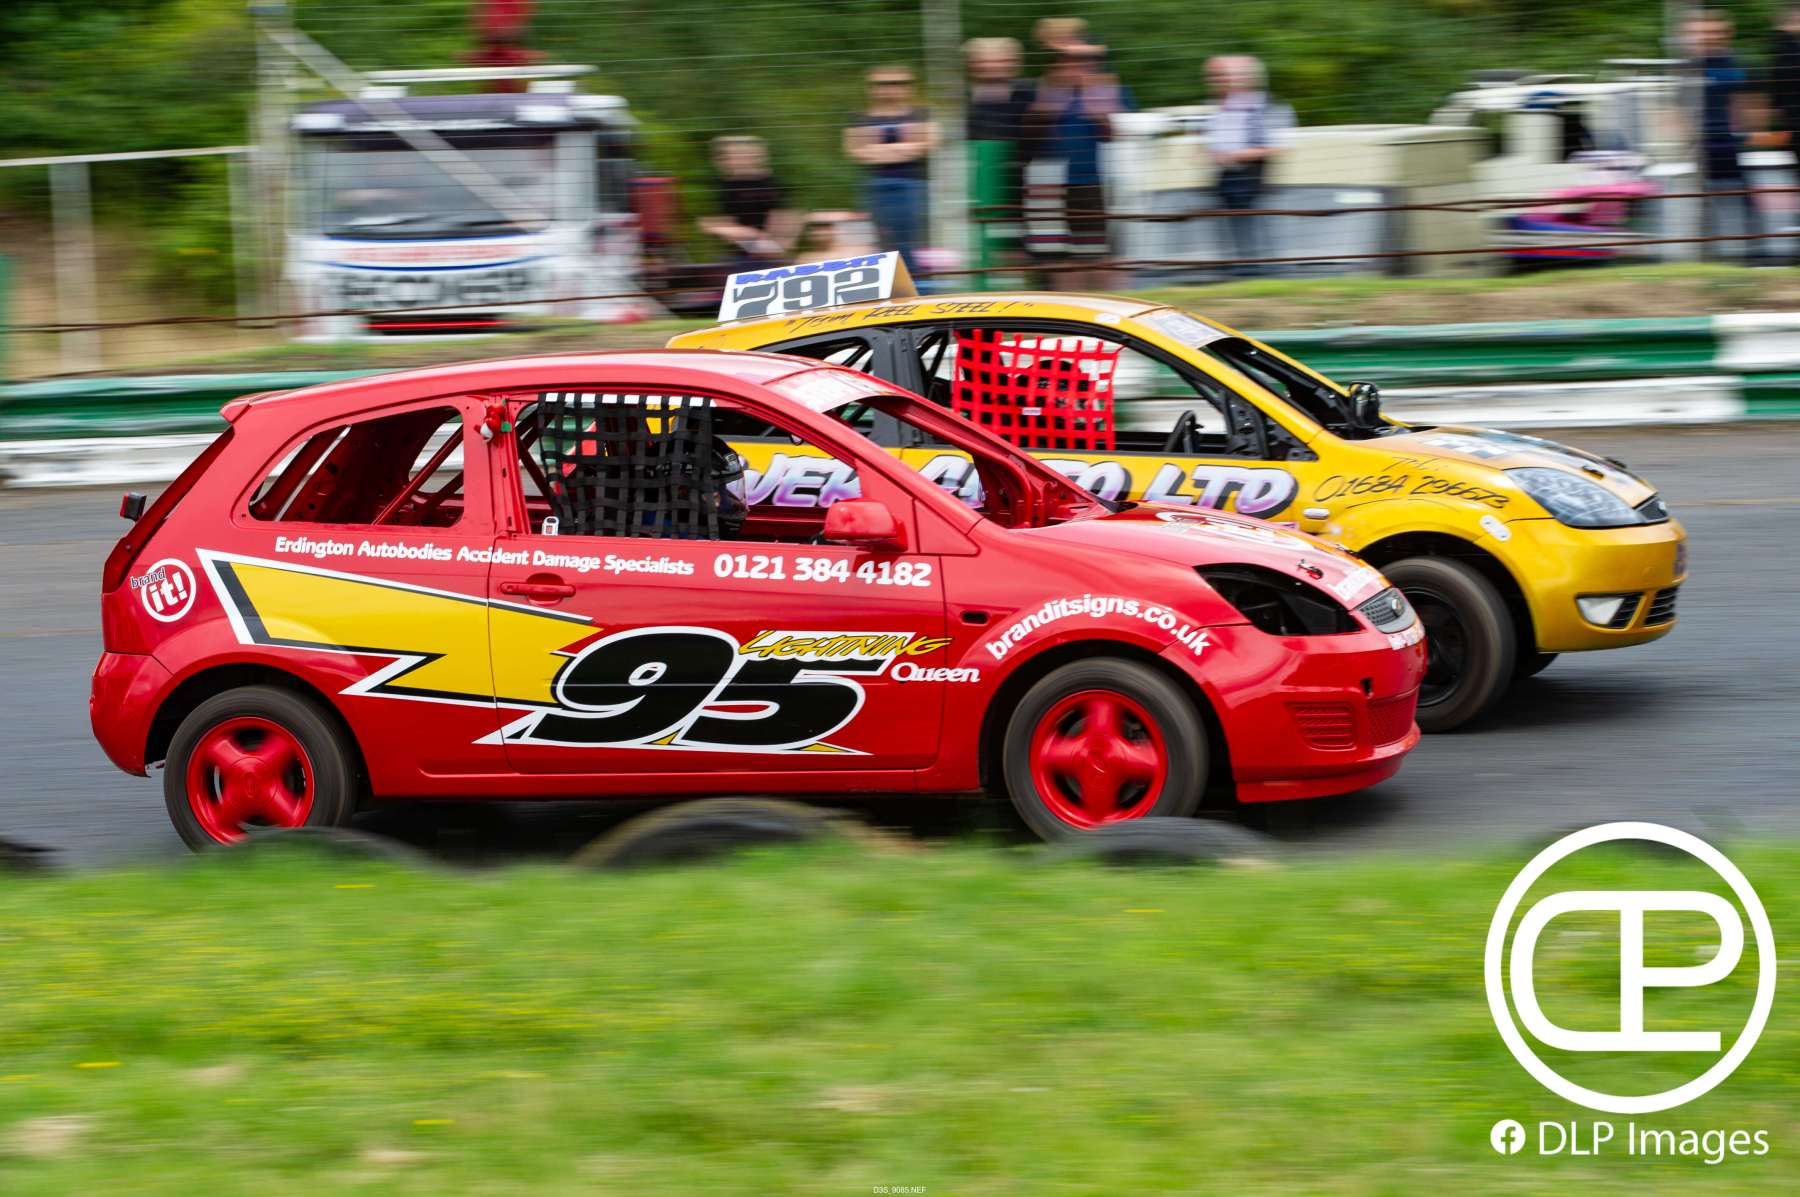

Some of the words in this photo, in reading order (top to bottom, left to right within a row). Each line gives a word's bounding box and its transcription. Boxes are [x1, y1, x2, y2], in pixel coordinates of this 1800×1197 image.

[733, 266, 881, 319] 792
[1143, 462, 1298, 519] LTD
[1313, 474, 1409, 502] 01684
[274, 536, 354, 558] Erdington
[357, 540, 452, 561] Autobodies
[456, 545, 529, 566] Accident
[532, 550, 600, 573] Damage
[603, 554, 694, 575] Specialists
[713, 553, 786, 580] 0121
[792, 556, 850, 582] 384
[855, 560, 932, 587] 4182
[130, 566, 167, 589] brand
[149, 571, 188, 612] it!
[738, 630, 953, 658] LIGHTNING
[985, 593, 1211, 661] branditsigns.co.uk
[488, 626, 868, 754] 95
[889, 661, 981, 683] Queen
